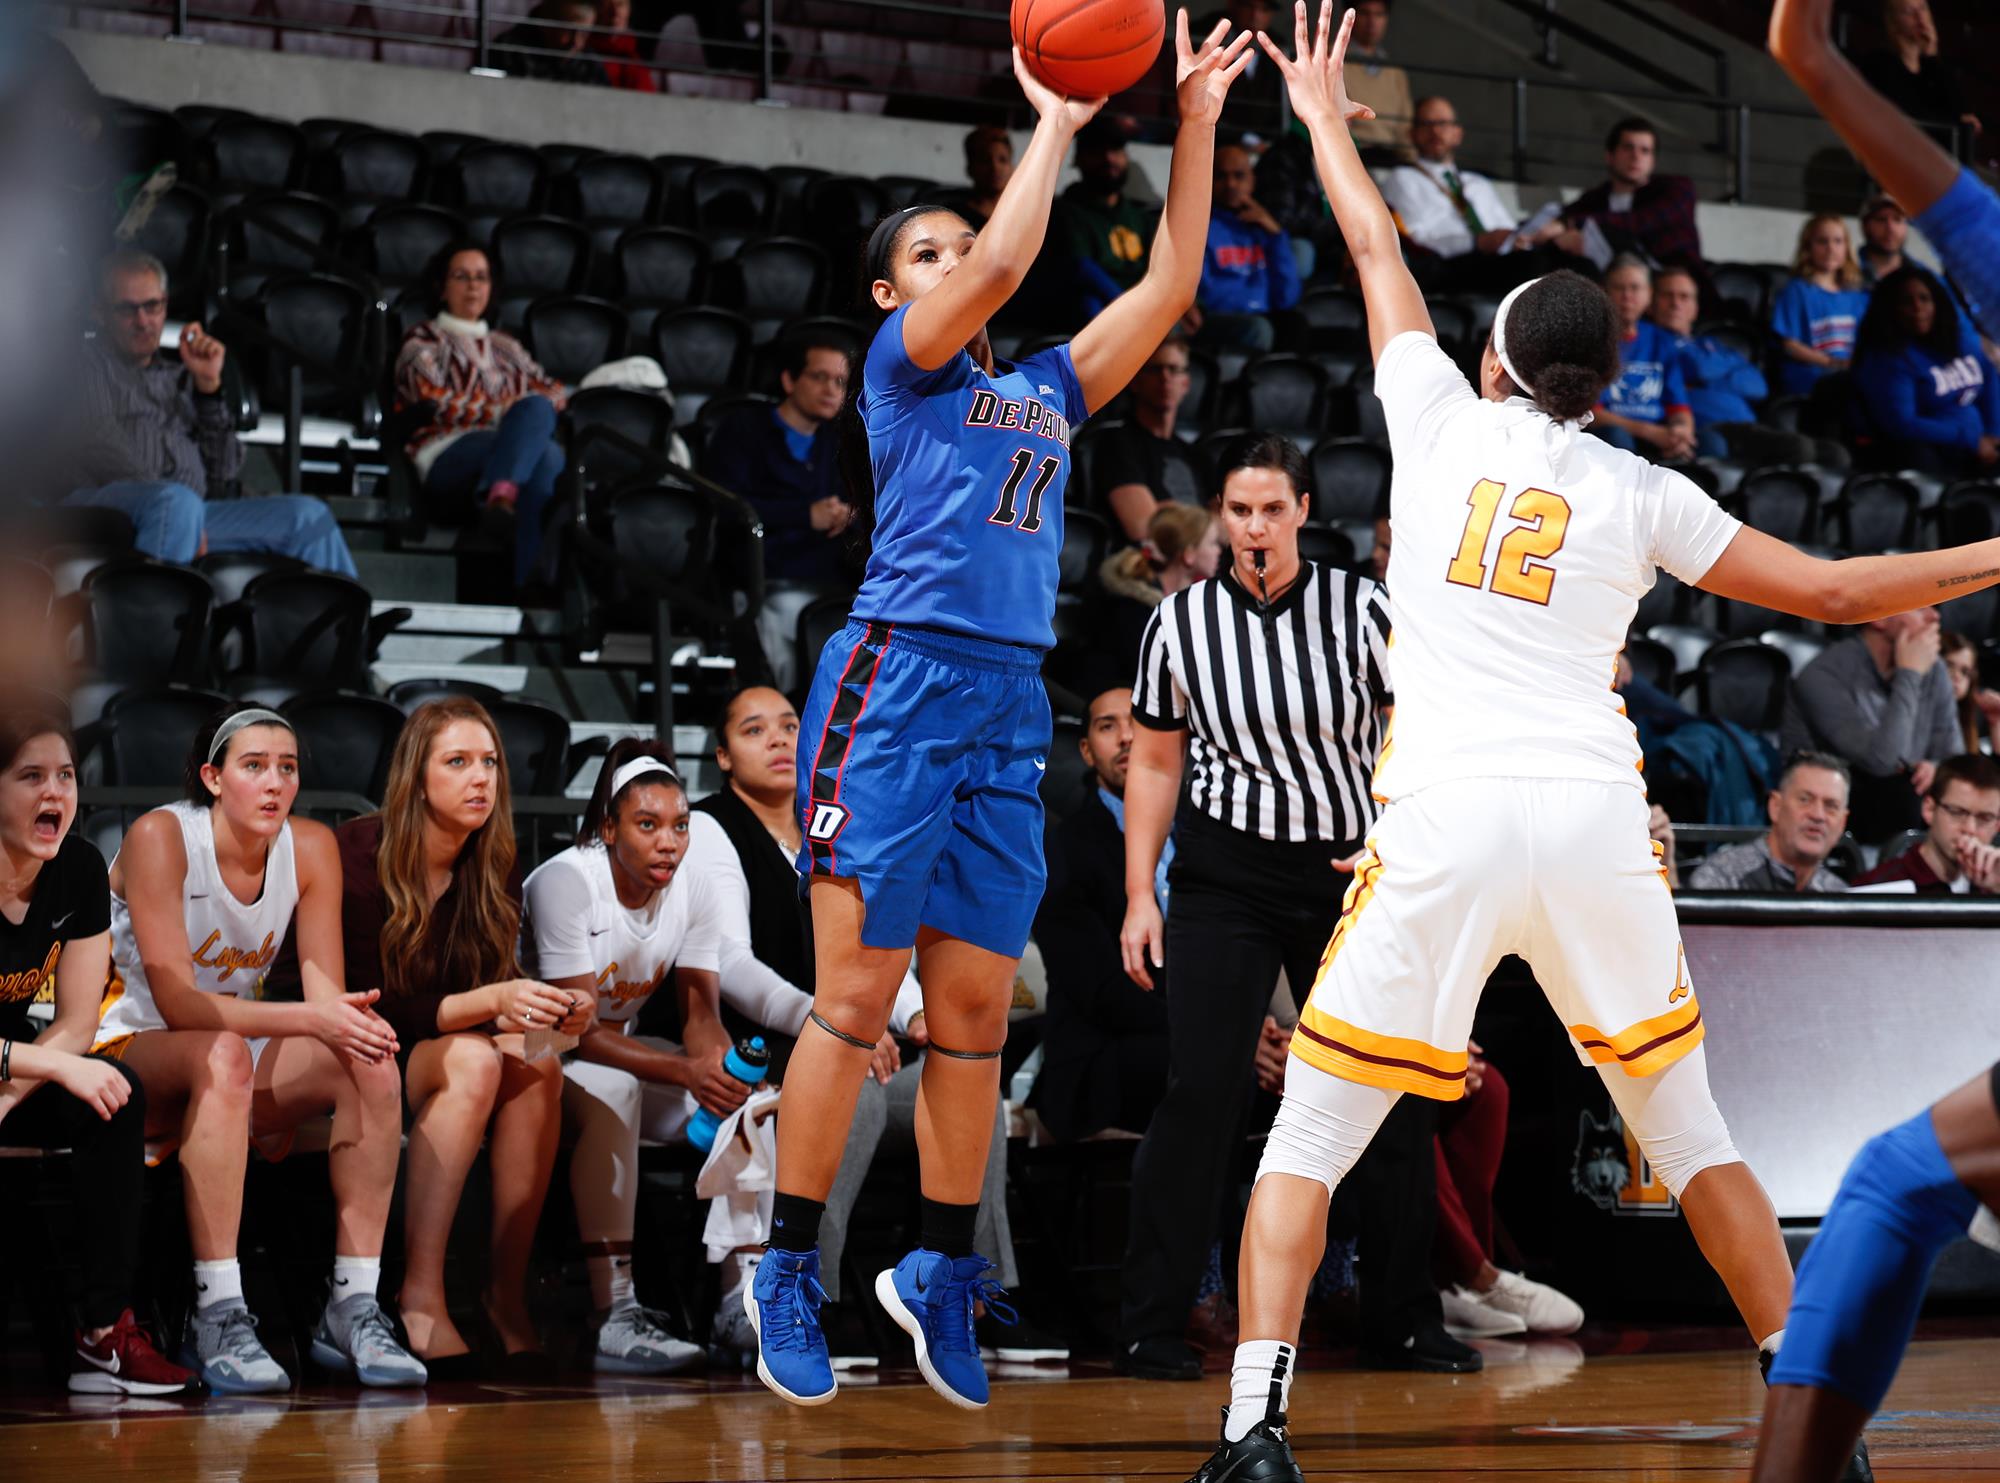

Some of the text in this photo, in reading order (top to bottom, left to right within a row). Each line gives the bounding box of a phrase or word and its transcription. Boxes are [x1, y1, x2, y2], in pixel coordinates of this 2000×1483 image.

[964, 388, 1071, 452] DEPAU
[987, 447, 1062, 534] 11
[1445, 477, 1572, 606] 12
[807, 801, 848, 841] D
